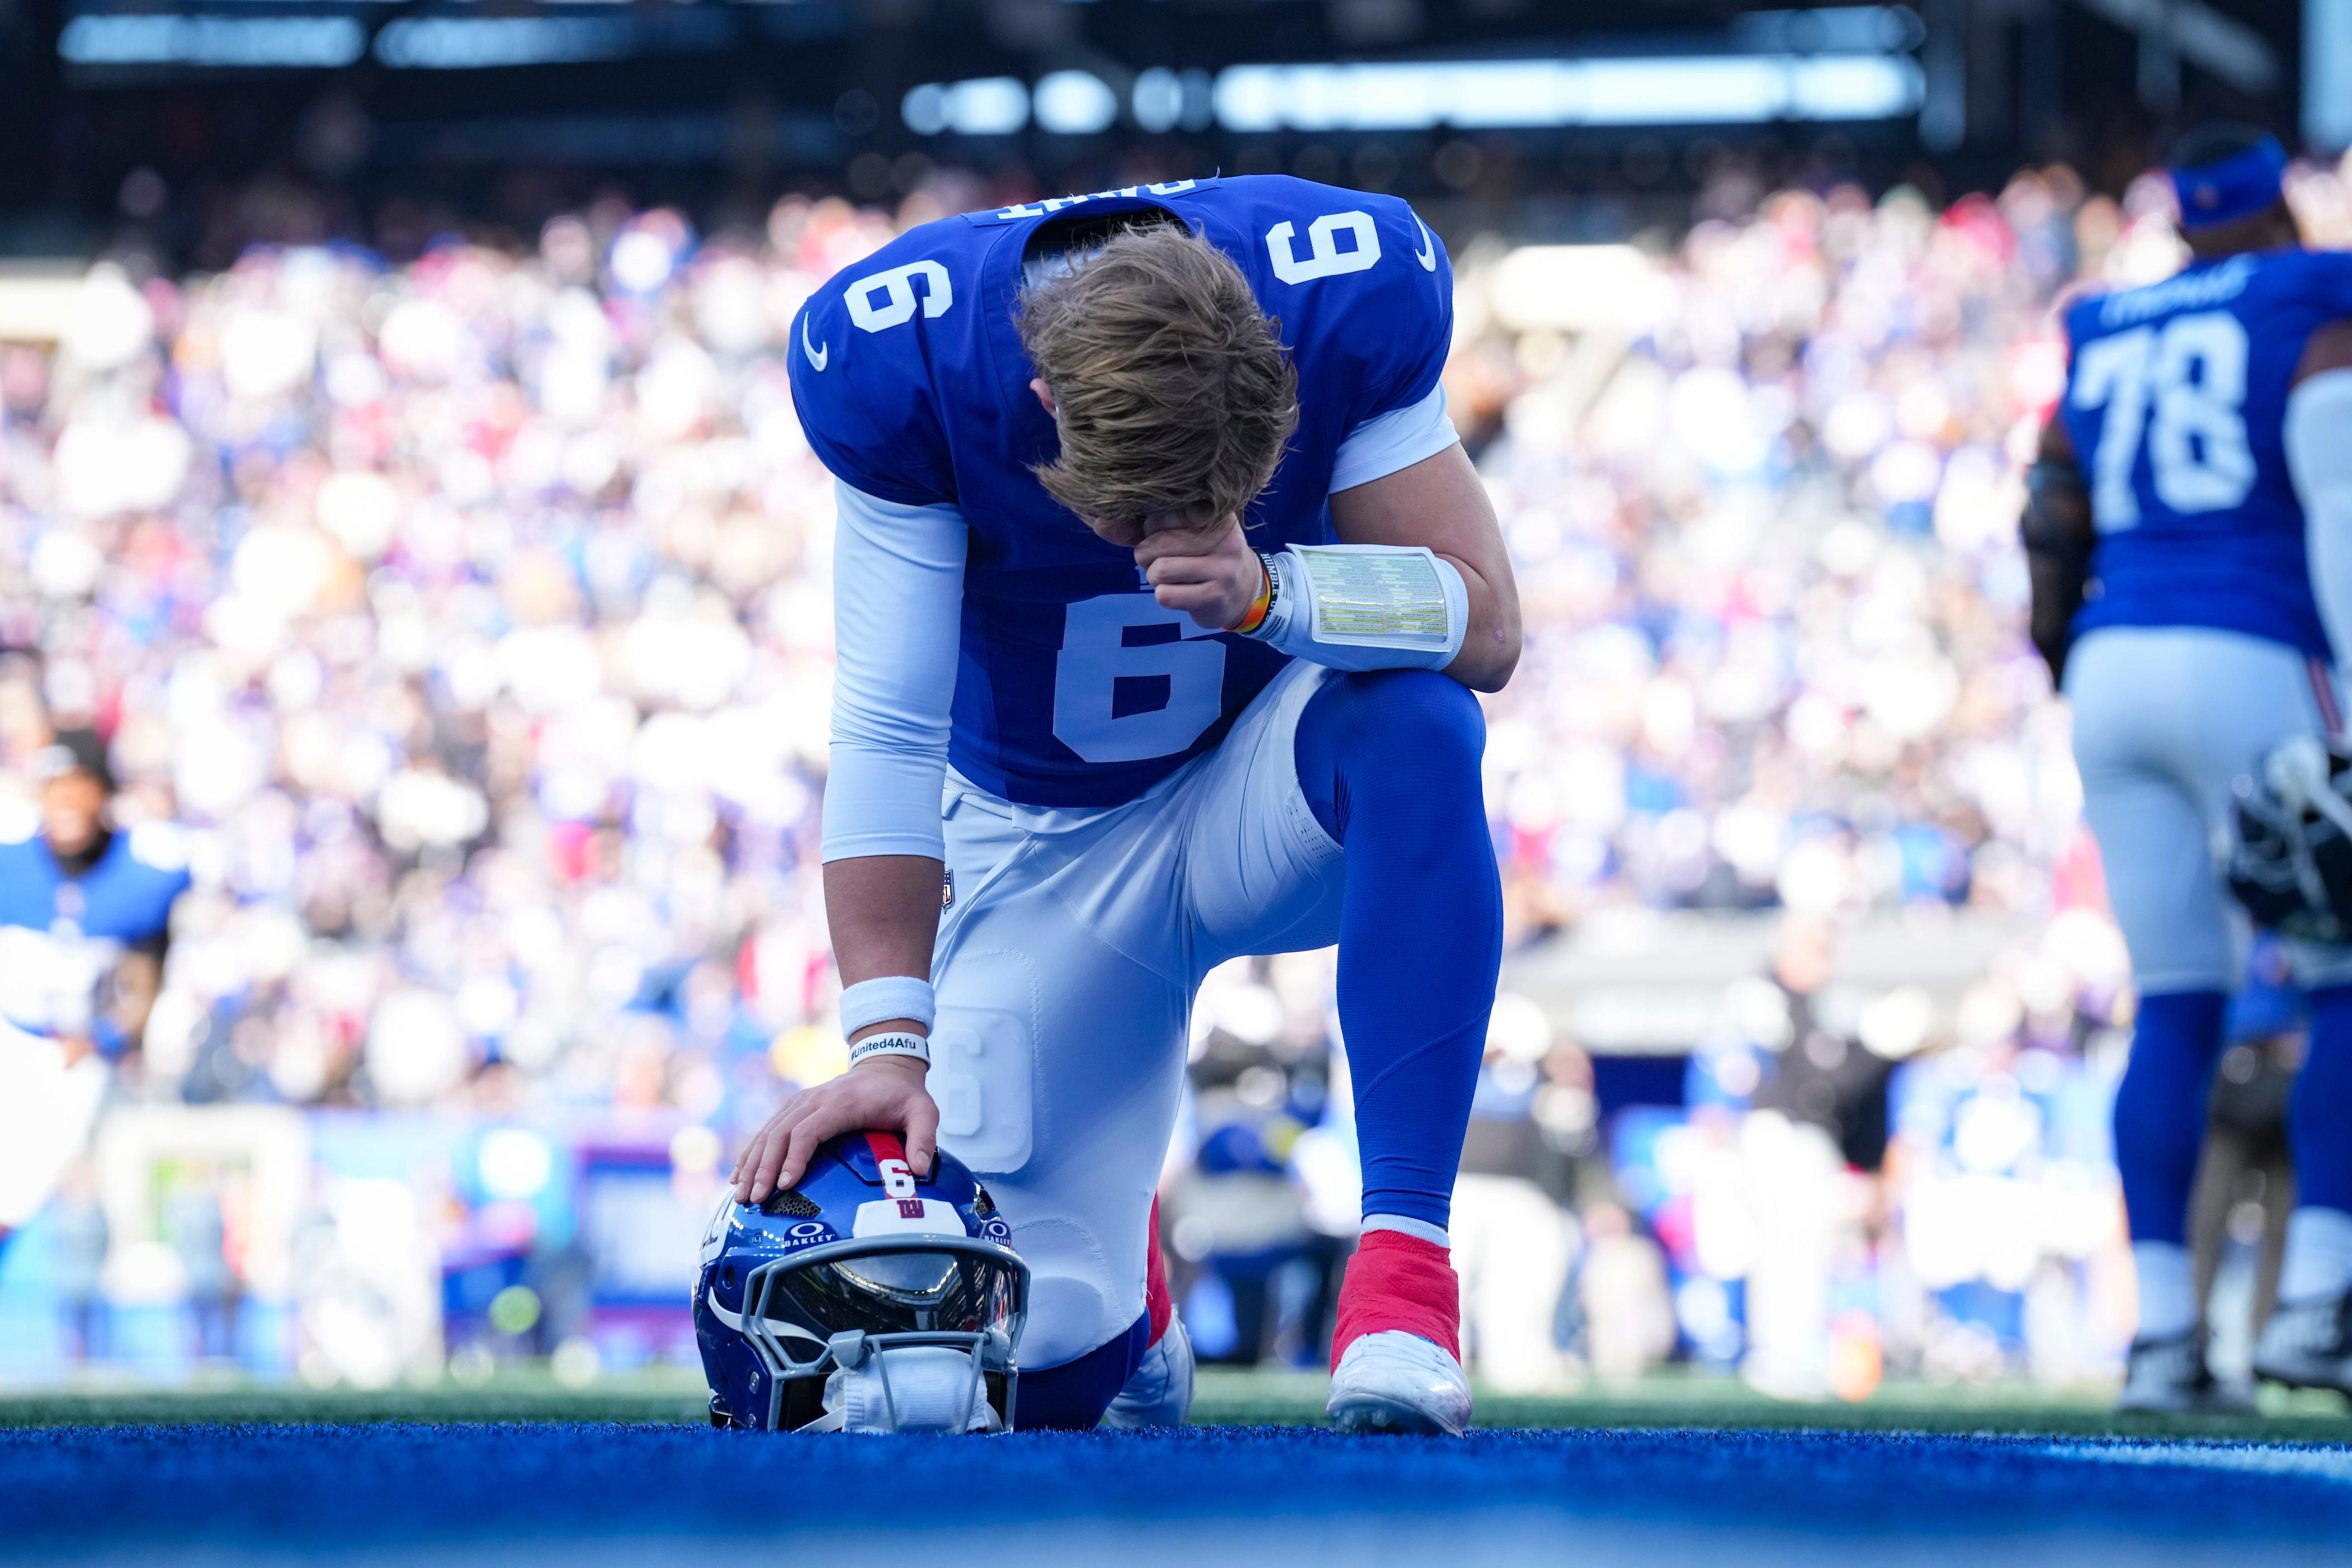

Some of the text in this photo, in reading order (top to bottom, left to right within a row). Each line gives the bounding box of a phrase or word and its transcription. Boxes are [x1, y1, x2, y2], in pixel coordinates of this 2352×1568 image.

[1265, 210, 1381, 286] 6
[843, 259, 953, 333] 6
[2071, 309, 2257, 534] 78
[1260, 553, 1279, 596] HUMBLE
[1052, 593, 1227, 763] 6
[851, 1038, 916, 1061] #United4Afu
[879, 1159, 917, 1198] 6
[785, 1234, 833, 1248] OAKLEY
[984, 1235, 1010, 1245] OAKLEY
